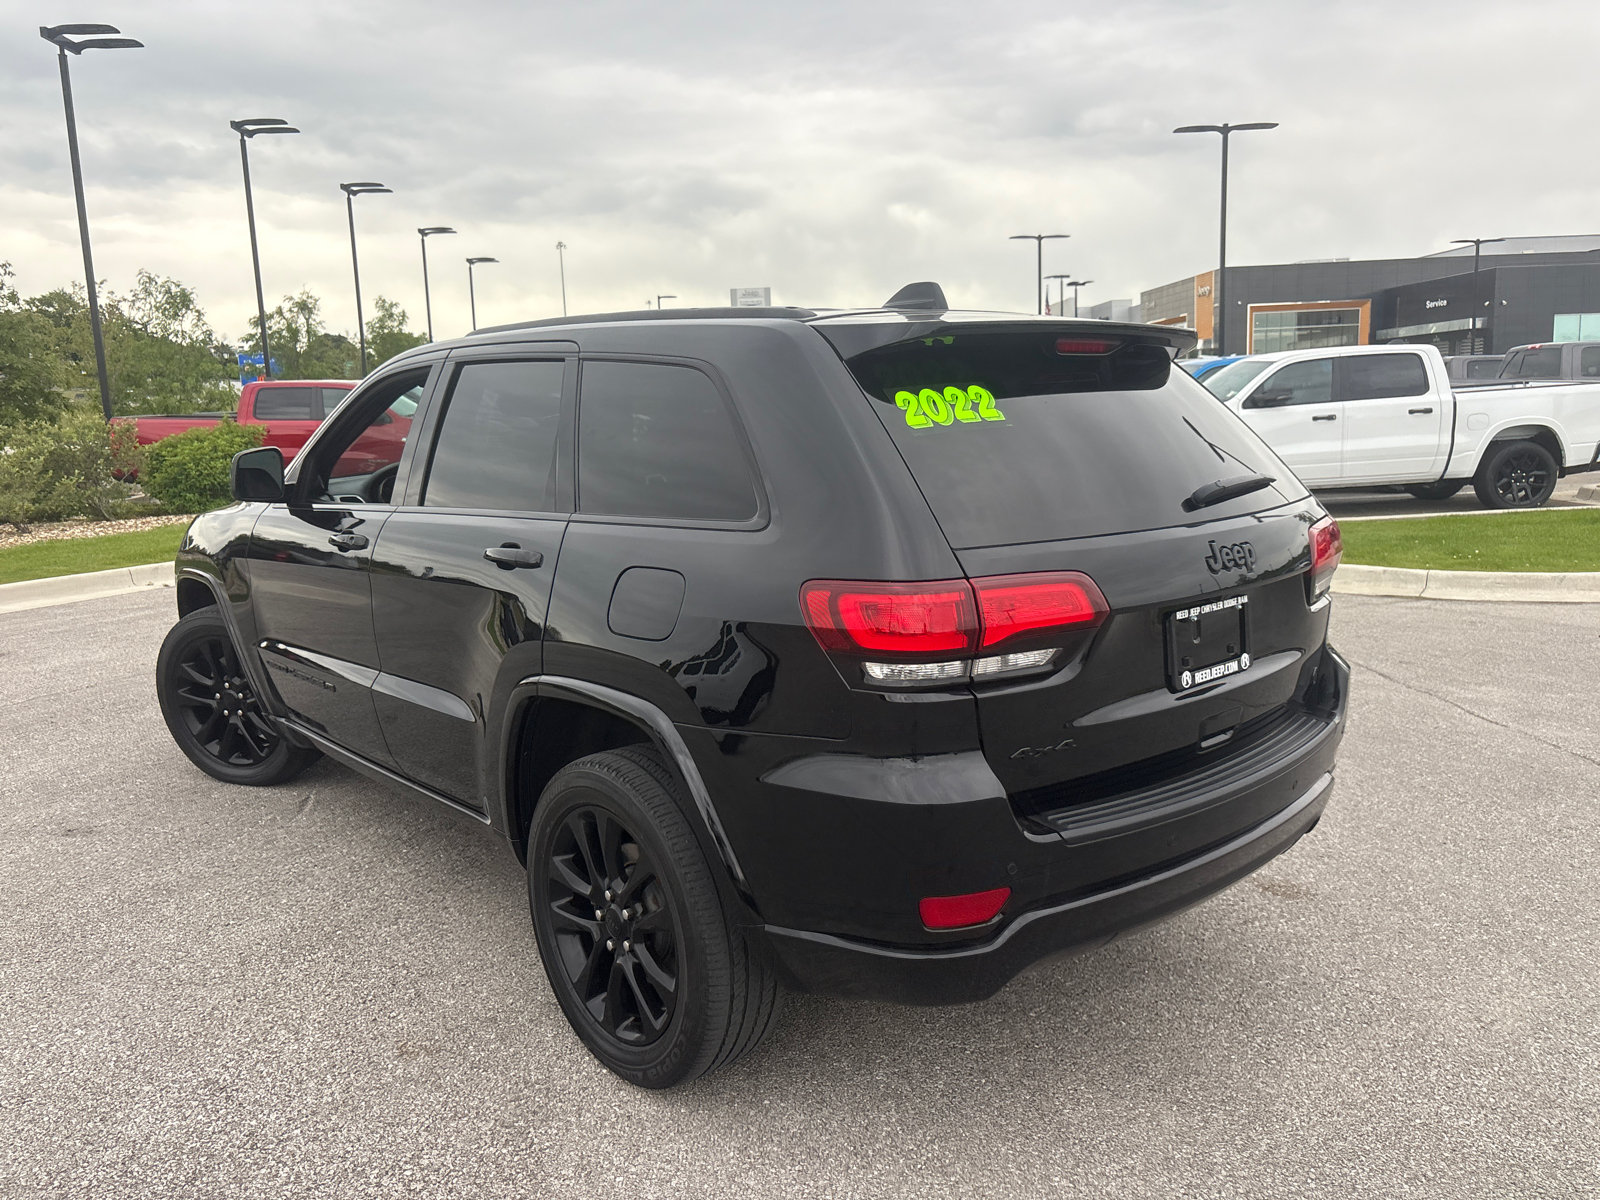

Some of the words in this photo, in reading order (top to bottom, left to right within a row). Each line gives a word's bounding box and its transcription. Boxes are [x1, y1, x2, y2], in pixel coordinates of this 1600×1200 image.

[1425, 298, 1448, 309] Service
[895, 385, 1006, 429] 2022
[1204, 540, 1257, 575] Jeep
[1176, 610, 1189, 620] REED
[1189, 607, 1201, 617] JEEP
[1201, 601, 1223, 614] CHRYSLER
[1223, 597, 1238, 609] DODGE
[1238, 594, 1249, 604] RAM
[1194, 660, 1239, 684] REEDJEEP.COM
